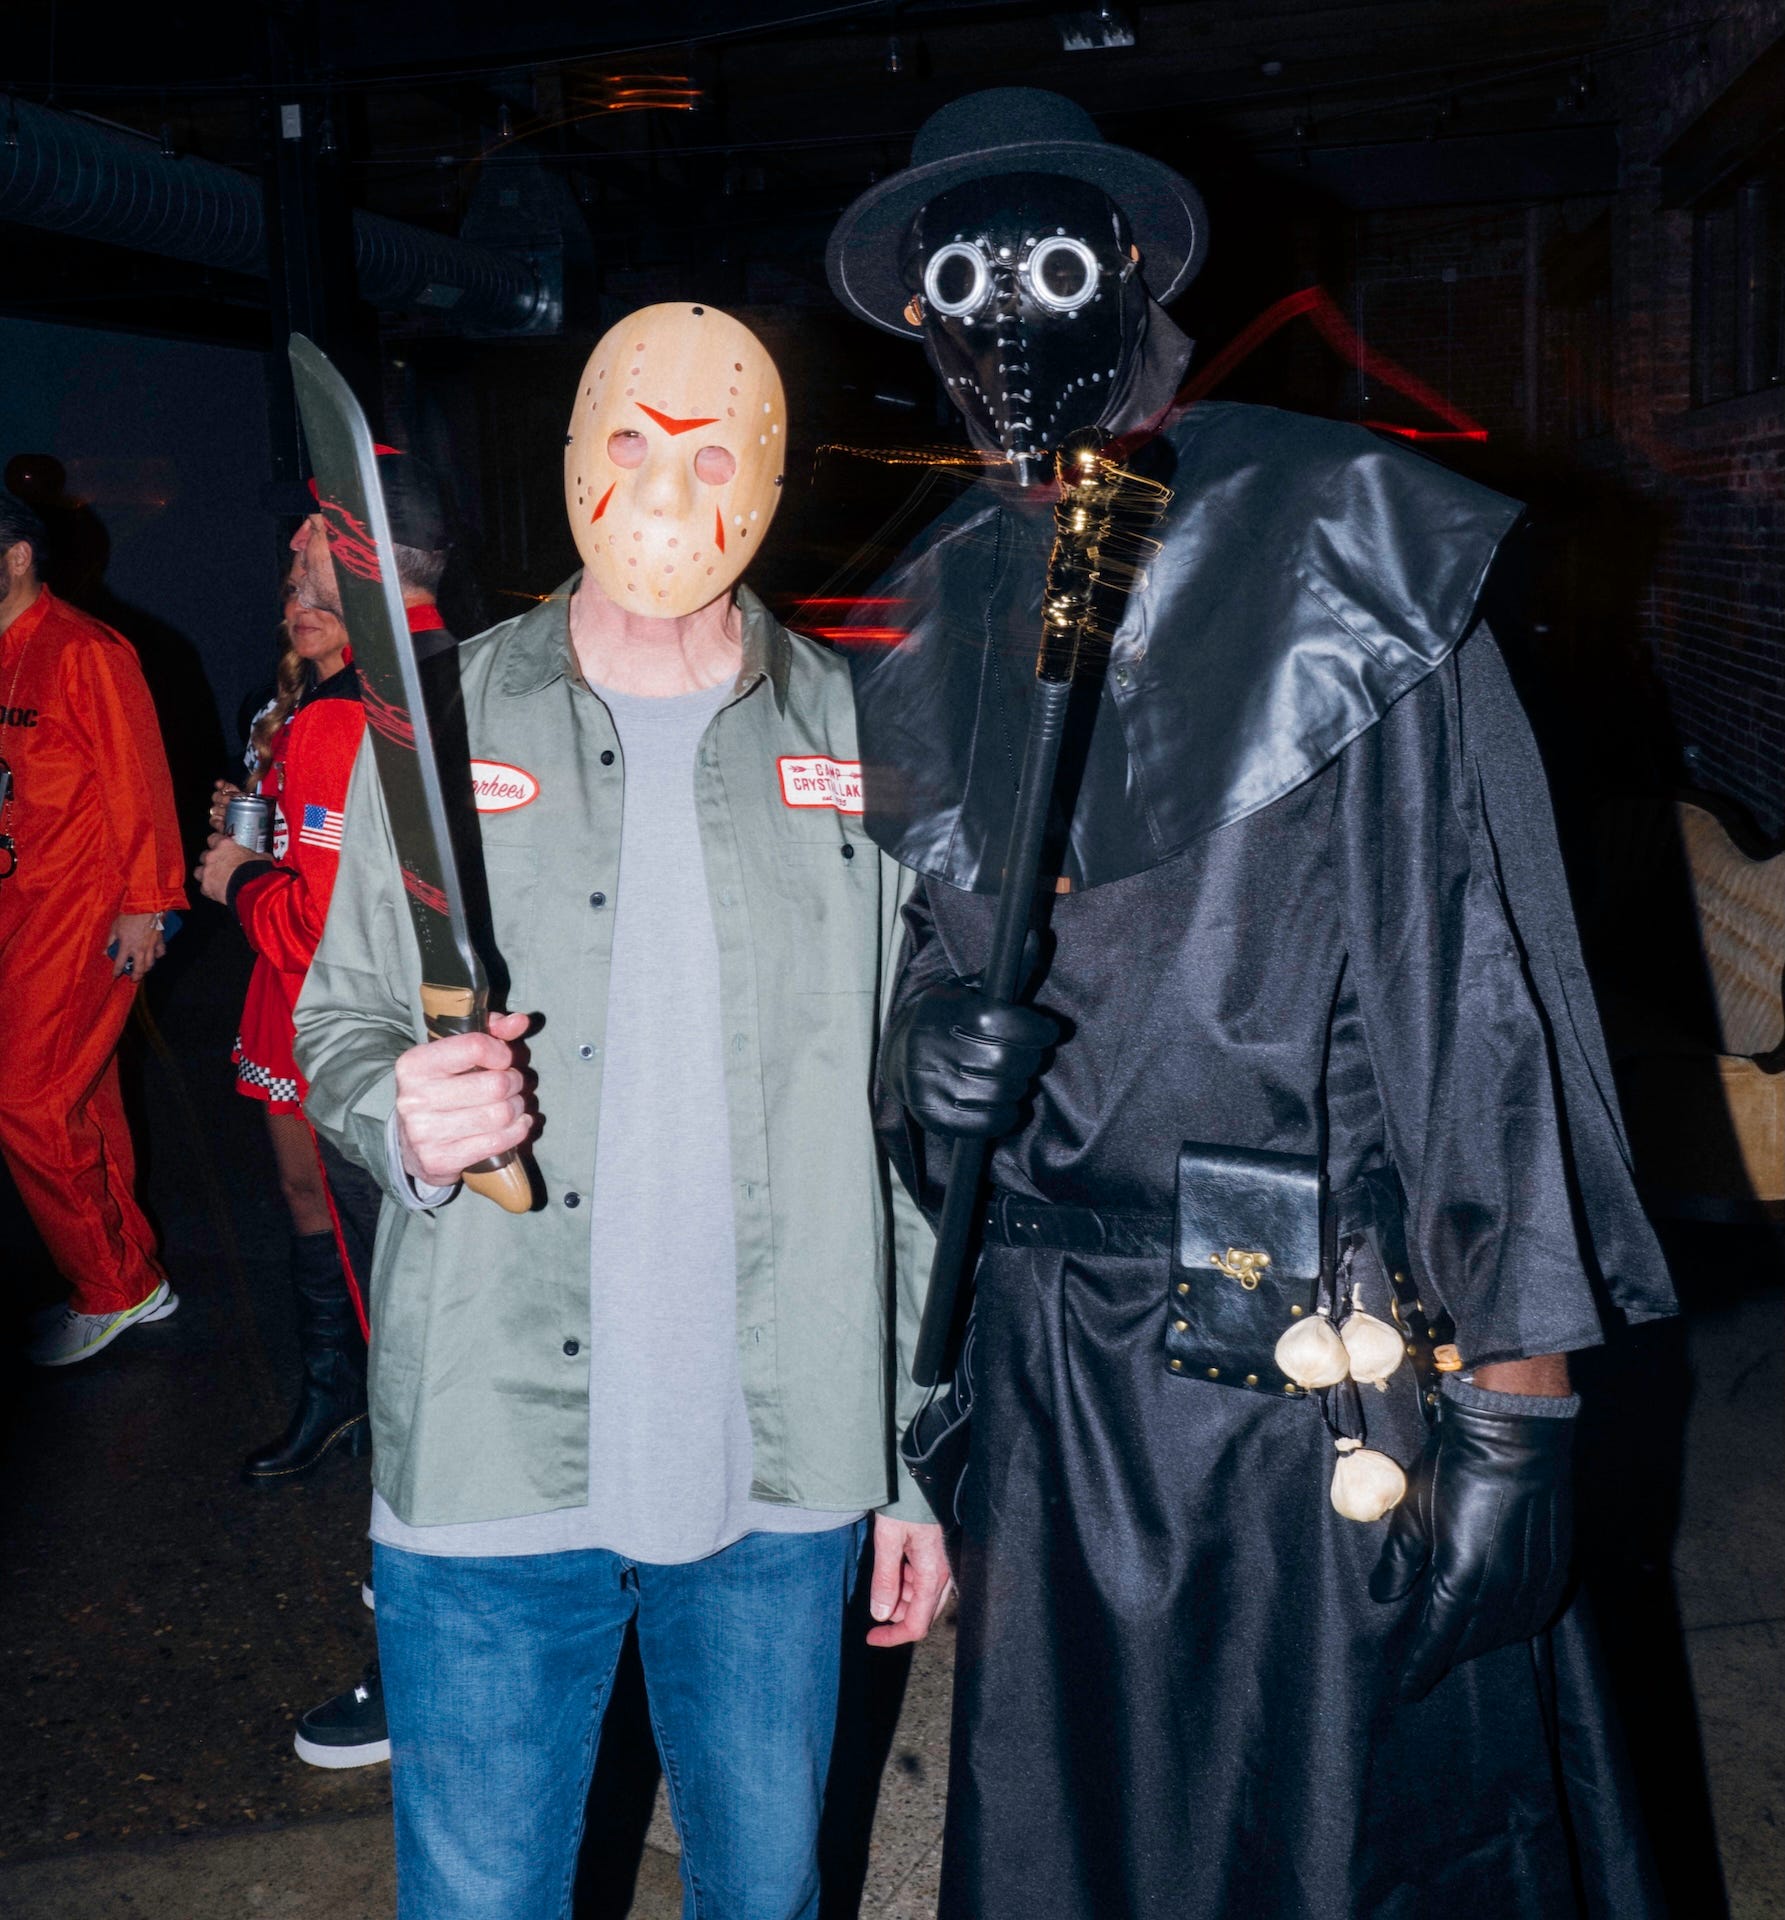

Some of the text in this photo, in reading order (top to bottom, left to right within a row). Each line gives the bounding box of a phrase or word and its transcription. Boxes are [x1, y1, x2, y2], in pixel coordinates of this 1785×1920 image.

[815, 763, 841, 780] CAMP
[472, 774, 526, 799] orhees
[839, 783, 863, 798] LAK
